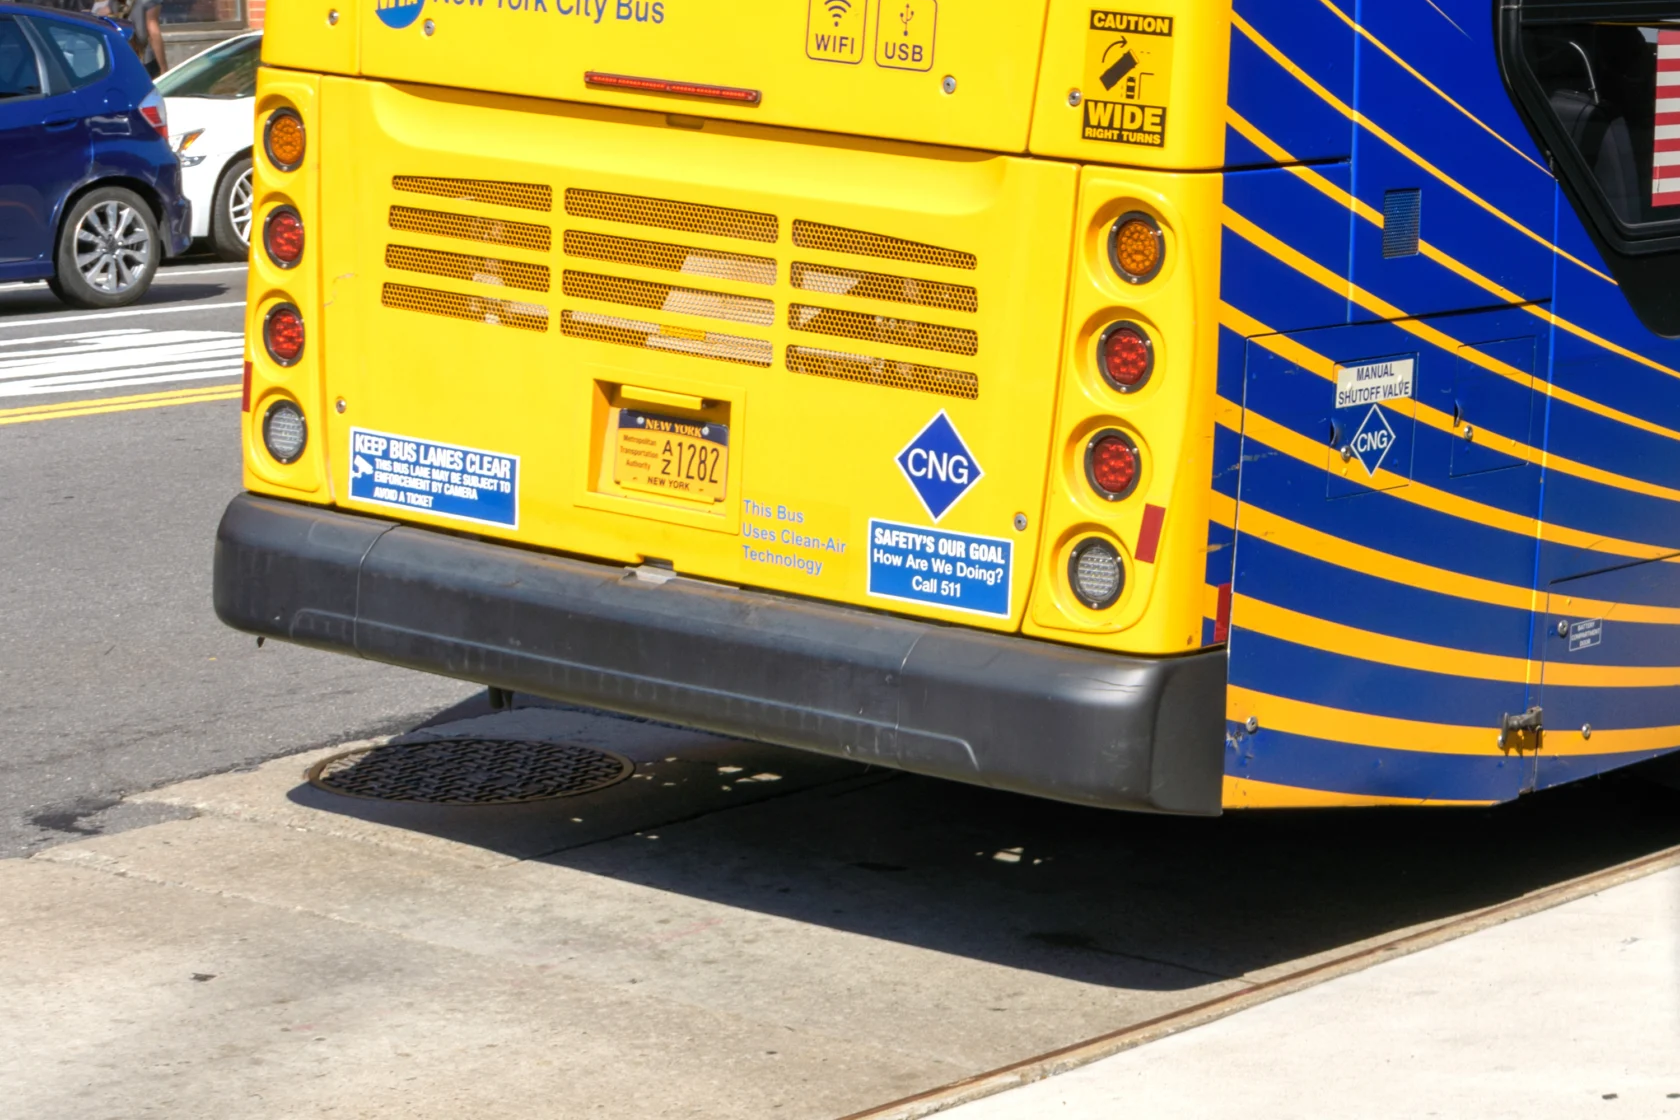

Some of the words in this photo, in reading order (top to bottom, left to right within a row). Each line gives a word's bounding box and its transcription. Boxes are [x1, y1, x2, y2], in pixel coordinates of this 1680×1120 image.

[1093, 12, 1170, 34] CAUTION
[815, 33, 855, 54] WIFI
[885, 41, 923, 62] USB
[1087, 101, 1163, 133] WIDE
[1085, 127, 1119, 140] RIGHT
[1121, 131, 1161, 145] TURNS
[1357, 363, 1395, 381] MANUAL
[1339, 386, 1380, 405] SHUTOFF
[1382, 381, 1410, 398] VALVE
[645, 418, 672, 432] NEW
[674, 423, 702, 438] YORK
[623, 435, 657, 447] Metropolitan
[1357, 429, 1388, 452] CNG
[355, 433, 388, 457] KEEP
[389, 439, 417, 463] BUS
[419, 445, 463, 471] LANES
[466, 453, 511, 479] CLEAR
[620, 445, 658, 459] Transportation
[677, 442, 720, 484] 1282
[375, 458, 393, 471] THIS
[393, 461, 410, 475] BUS
[410, 464, 431, 479] LANE
[431, 467, 450, 482] MAY
[450, 472, 462, 484] BE
[463, 474, 499, 491] SUBJECT
[500, 480, 512, 494] TO
[626, 459, 651, 471] Authority
[907, 447, 970, 485] CNG
[374, 472, 431, 491] ENFORCEMENT
[431, 482, 443, 493] BY
[444, 483, 478, 500] CAMERA
[647, 476, 667, 487] NEW
[669, 479, 690, 491] YORK
[373, 487, 398, 502] AVOID
[399, 491, 405, 503] A
[406, 492, 434, 508] TICKET
[743, 499, 772, 519] This
[777, 505, 804, 523] Bus
[742, 522, 776, 542] Uses
[781, 526, 847, 555] Clean-Air
[874, 528, 935, 553] SAFETY'S
[938, 538, 966, 559] OUR
[969, 543, 1006, 564] GOAL
[742, 545, 823, 576] Technology
[874, 548, 902, 567] How
[906, 556, 928, 572] Are
[932, 557, 952, 575] We
[956, 561, 1003, 586] Doing?
[912, 575, 937, 594] Call
[941, 580, 961, 598] 511
[1571, 628, 1601, 641] COMPARTMENT
[1577, 621, 1595, 632] BATTERY
[1579, 638, 1591, 647] DOOR
